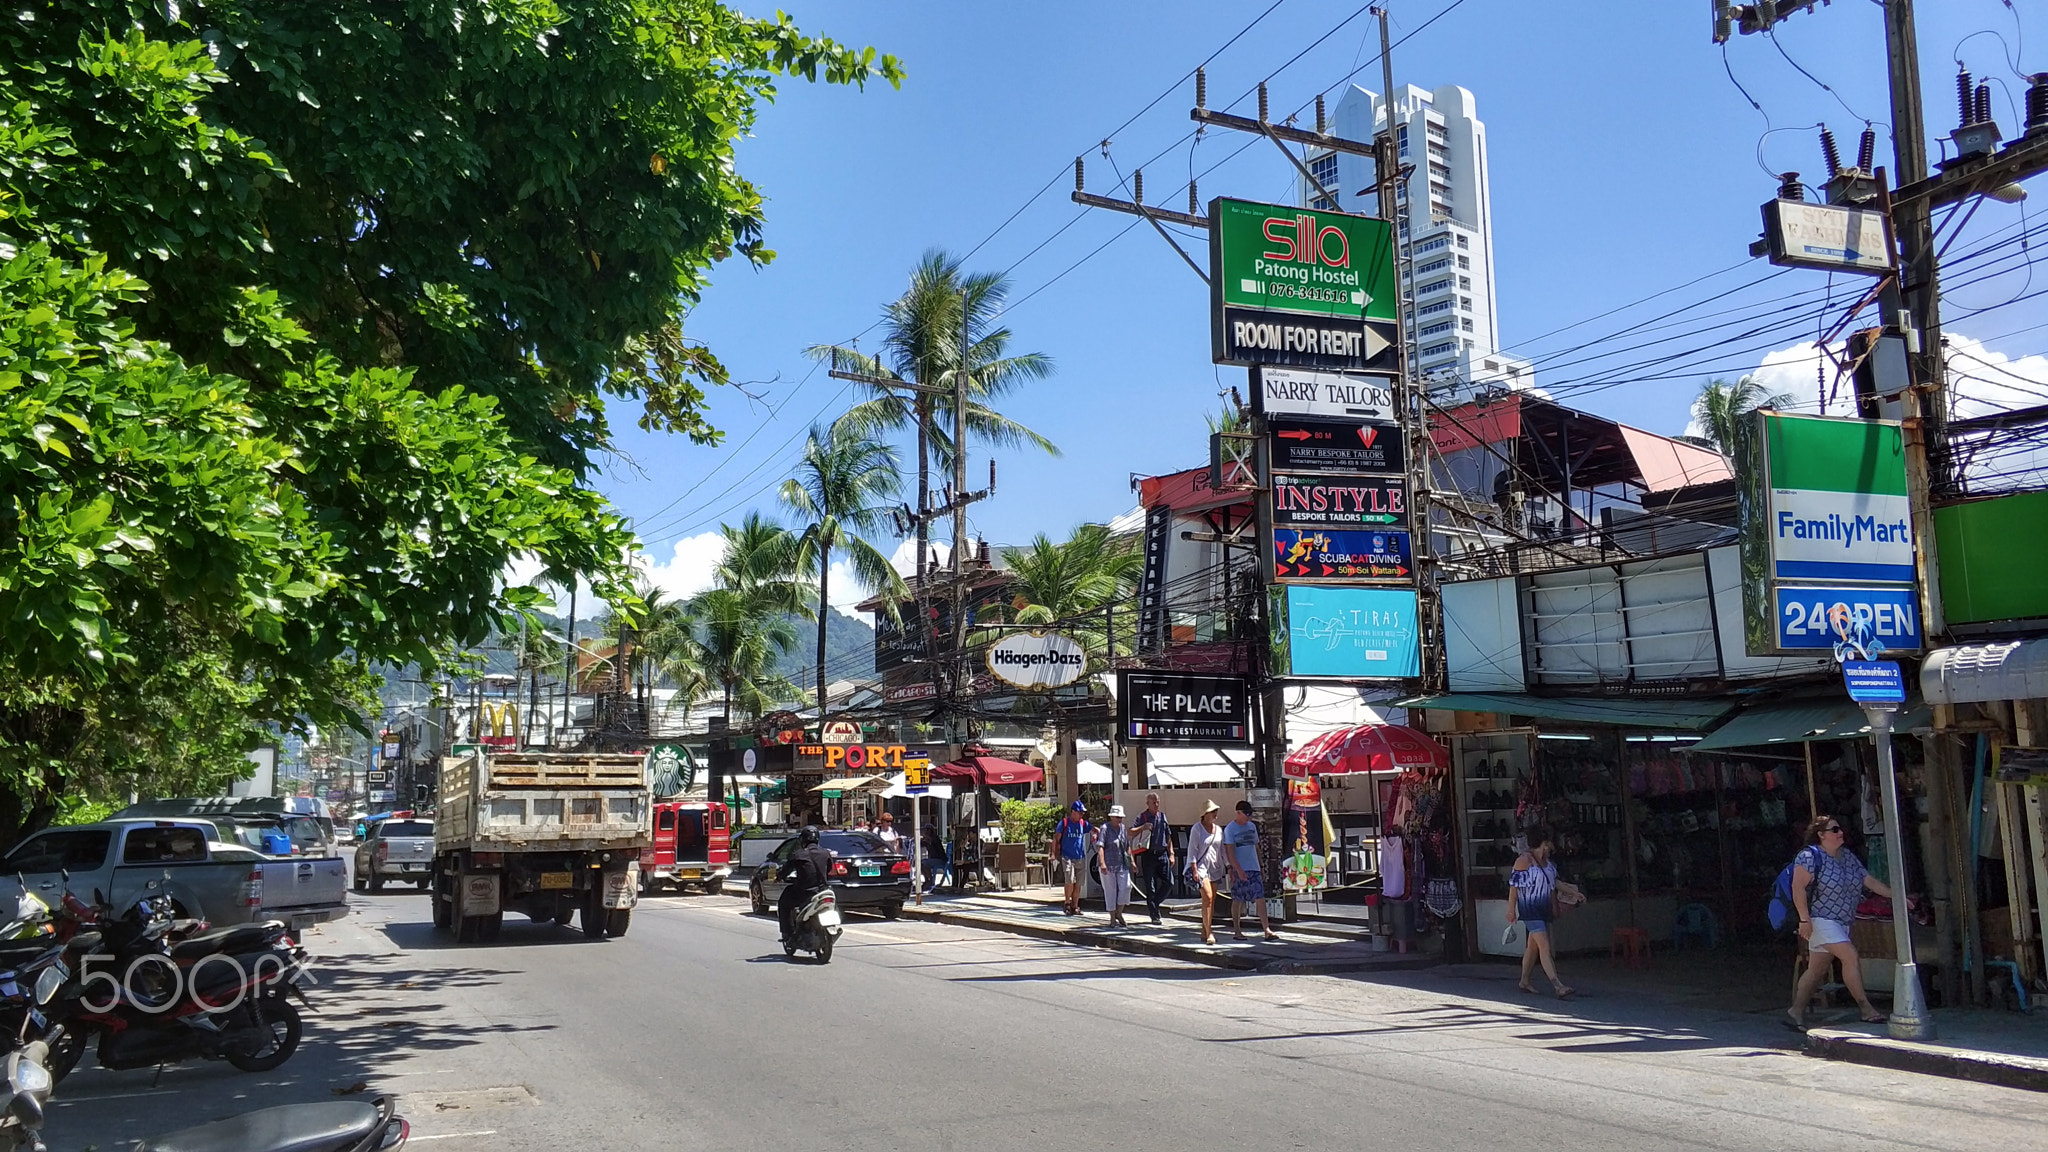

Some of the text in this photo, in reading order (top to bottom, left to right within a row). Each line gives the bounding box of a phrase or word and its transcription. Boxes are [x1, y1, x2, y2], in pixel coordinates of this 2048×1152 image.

[1255, 259, 1360, 286] Patong Hostel
[1269, 282, 1348, 304] 076-341616
[1233, 321, 1363, 357] ROOM FOR RENT
[1266, 379, 1391, 407] NARRY TAILORS
[1325, 432, 1332, 440] M
[1289, 449, 1384, 459] NARRY BESPOKE TAILORS
[1275, 485, 1405, 513] INSTYLE
[1292, 513, 1361, 522] BESPOKE TAILORS
[1777, 511, 1909, 548] FamilyMart
[1338, 566, 1402, 576] 50m Soi Wattana
[1350, 610, 1399, 628] TIRAS
[994, 649, 1081, 669] Häagen-Dazs
[1893, 669, 1899, 677] 2
[1142, 693, 1232, 714] THE PLACE
[828, 733, 858, 742] CHICAGO
[1148, 726, 1227, 736] BAR RESTAURANT
[799, 745, 907, 768] THE PORT
